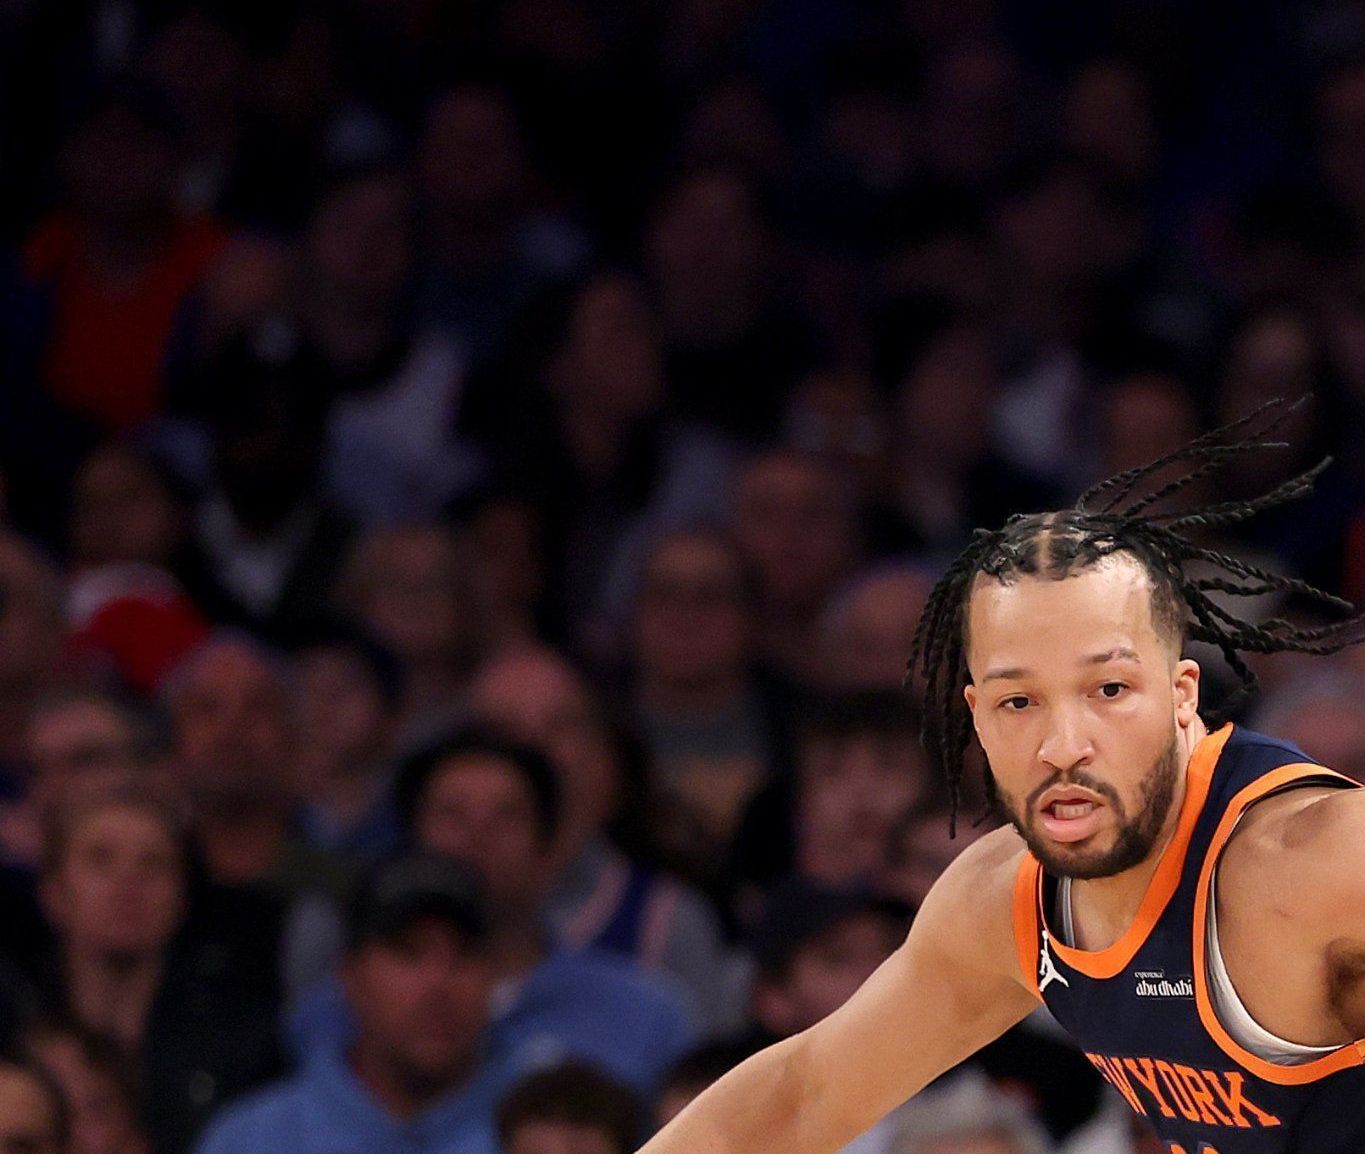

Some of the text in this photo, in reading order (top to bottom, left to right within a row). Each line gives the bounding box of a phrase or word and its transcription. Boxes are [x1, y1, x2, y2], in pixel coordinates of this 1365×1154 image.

[1136, 979, 1194, 997] abu dhabi
[1122, 1057, 1282, 1128] YORK
